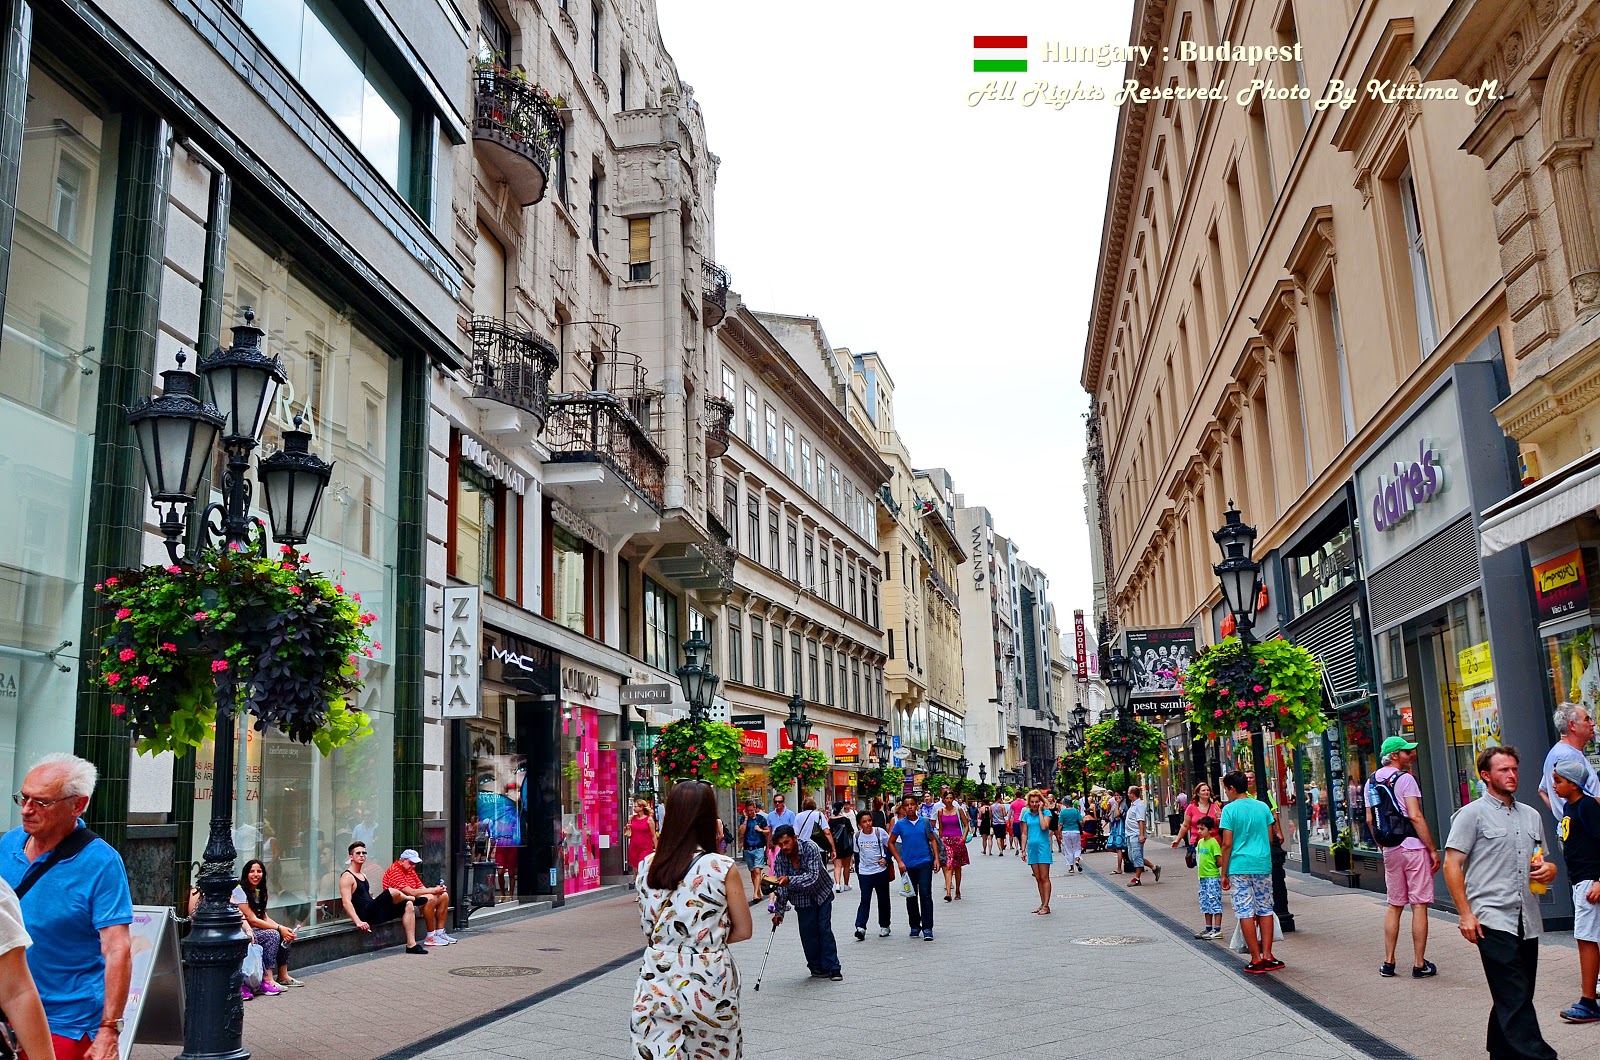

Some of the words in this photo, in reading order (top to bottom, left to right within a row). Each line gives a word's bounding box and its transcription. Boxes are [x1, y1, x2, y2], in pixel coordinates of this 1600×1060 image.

[1372, 437, 1442, 532] claire's
[971, 525, 985, 592] FONTANA
[1551, 604, 1562, 615] Váci
[447, 597, 472, 706] ZARA
[621, 689, 667, 700] CLINIQUE
[1133, 701, 1157, 713] pesti
